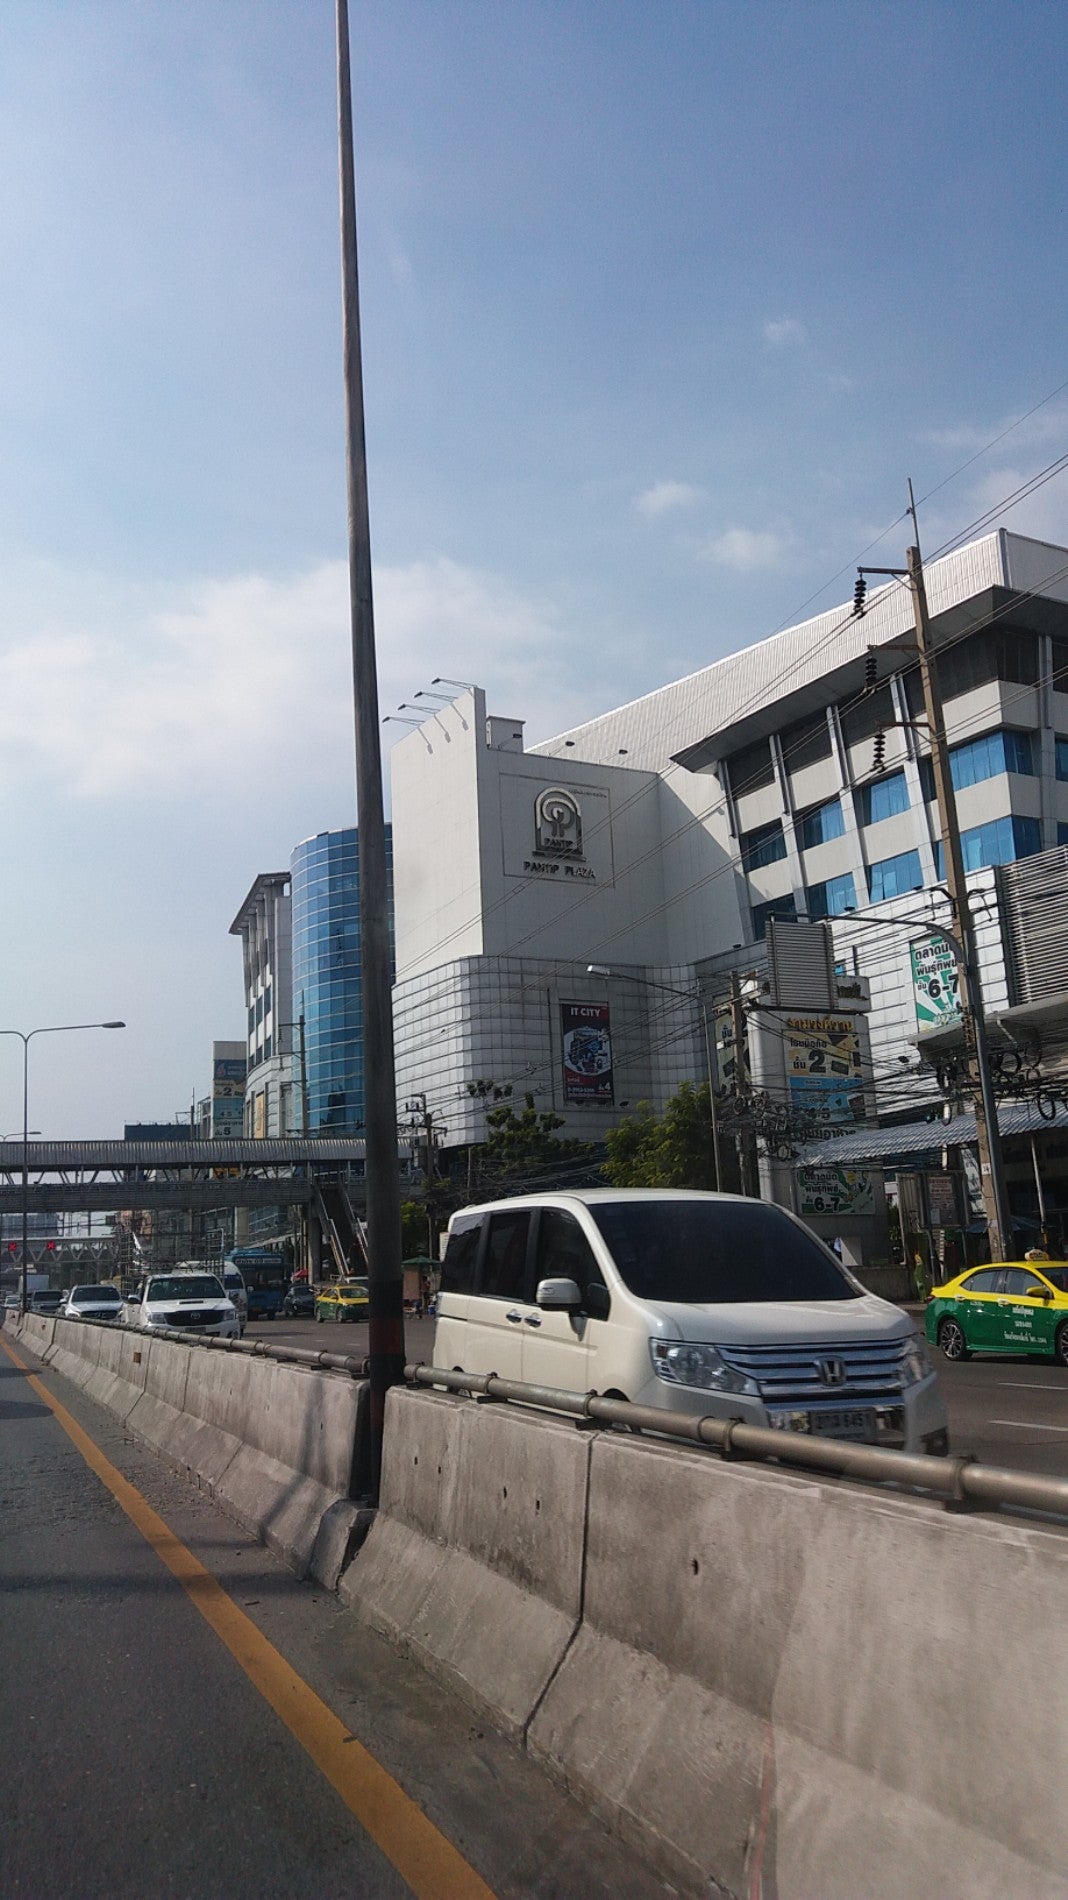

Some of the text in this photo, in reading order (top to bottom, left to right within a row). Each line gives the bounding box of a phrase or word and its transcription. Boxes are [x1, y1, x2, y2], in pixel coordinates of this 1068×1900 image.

[523, 861, 596, 879] PANTIP PLAZA
[928, 973, 959, 998] 6-7
[570, 1007, 600, 1017] IT CITY
[808, 1049, 826, 1073] 2
[223, 1087, 232, 1096] 2
[814, 1197, 840, 1211] 6-7
